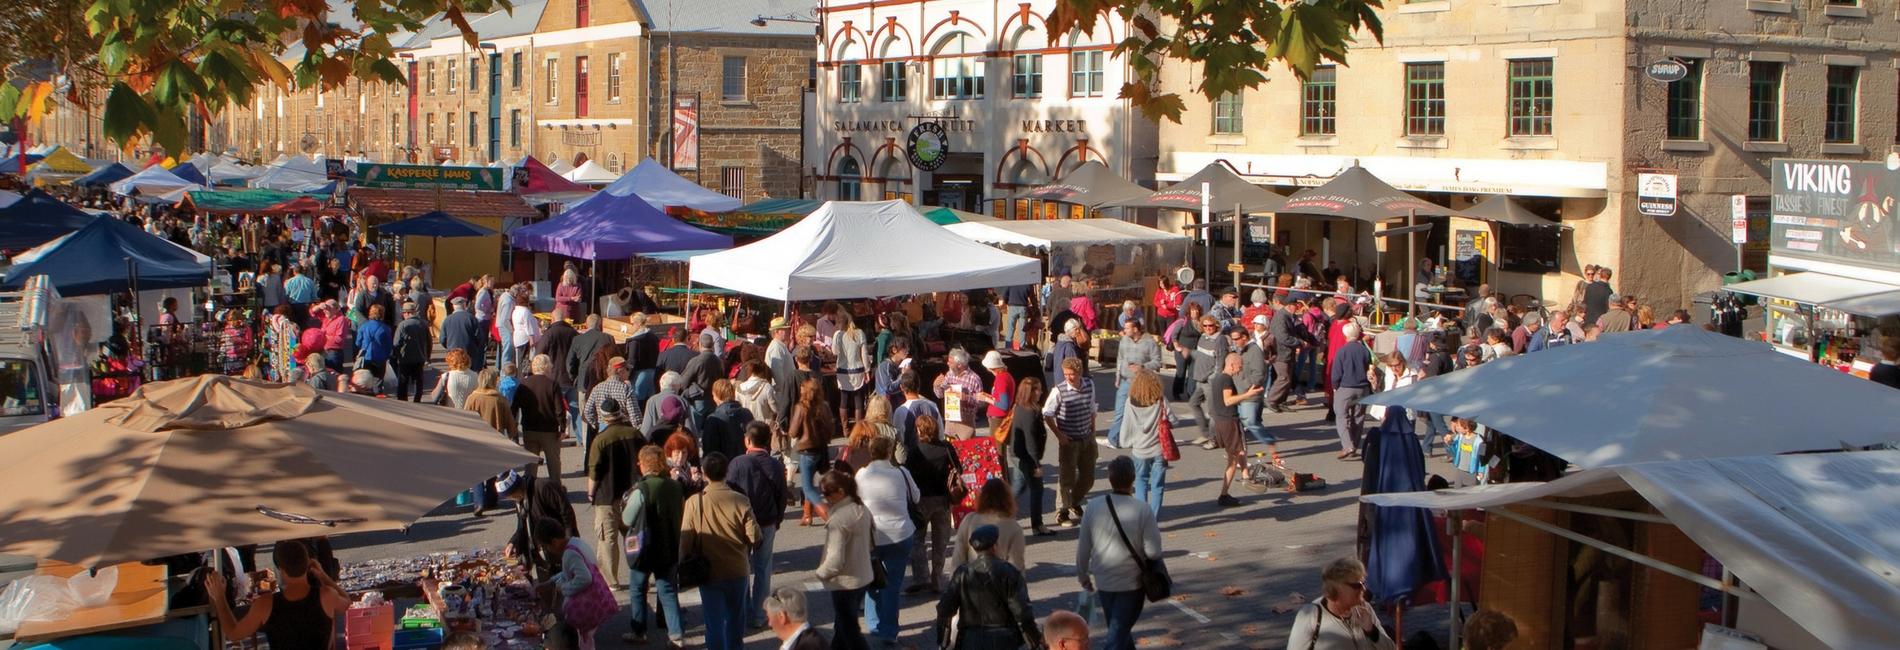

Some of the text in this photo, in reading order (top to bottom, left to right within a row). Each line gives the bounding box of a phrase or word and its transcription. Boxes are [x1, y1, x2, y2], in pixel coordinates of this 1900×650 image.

[1651, 64, 1680, 75] SYRUP
[834, 120, 904, 132] SALAMANCA
[1021, 119, 1087, 132] MARKET
[912, 122, 945, 139] FRESH
[387, 168, 472, 181] KASPERLE HAUS
[1783, 163, 1851, 194] VIKING
[1774, 193, 1849, 217] TASSIE'S FINEST
